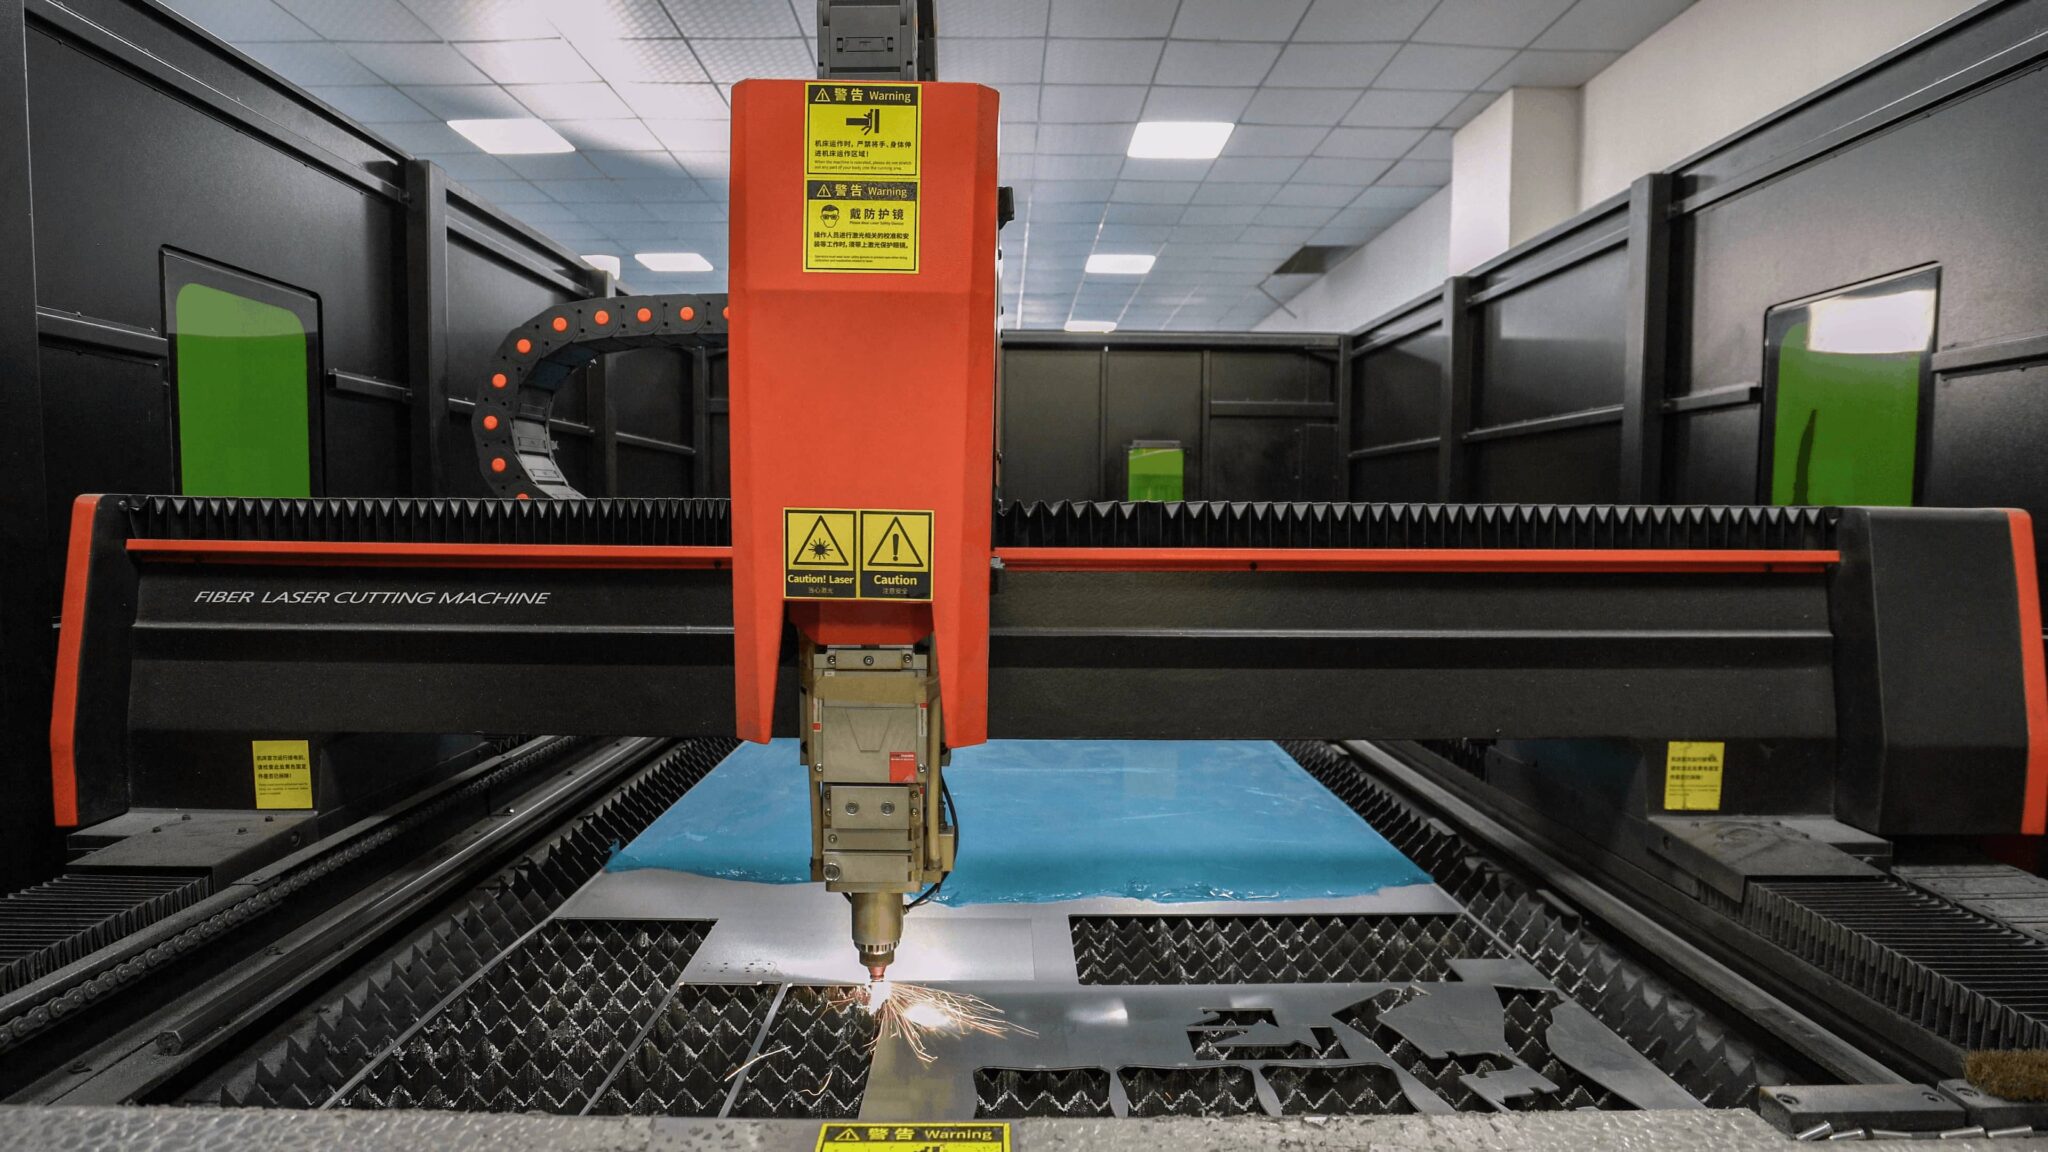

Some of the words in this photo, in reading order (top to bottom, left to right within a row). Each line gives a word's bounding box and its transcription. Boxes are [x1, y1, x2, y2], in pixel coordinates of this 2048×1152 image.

[834, 88, 863, 102] 警告
[869, 90, 911, 103] Warning
[835, 184, 863, 197] 警告
[868, 186, 908, 198] Warning
[849, 208, 904, 221] 戴防护镜
[787, 574, 827, 584] Caution!
[829, 575, 854, 585] Laser
[873, 574, 918, 585] Caution
[194, 591, 255, 604] FIBER
[261, 591, 331, 604] LASER
[334, 591, 436, 604] CUTTING
[438, 592, 552, 605] MACHINE
[868, 1127, 915, 1141] 警告
[924, 1129, 993, 1141] Warning
